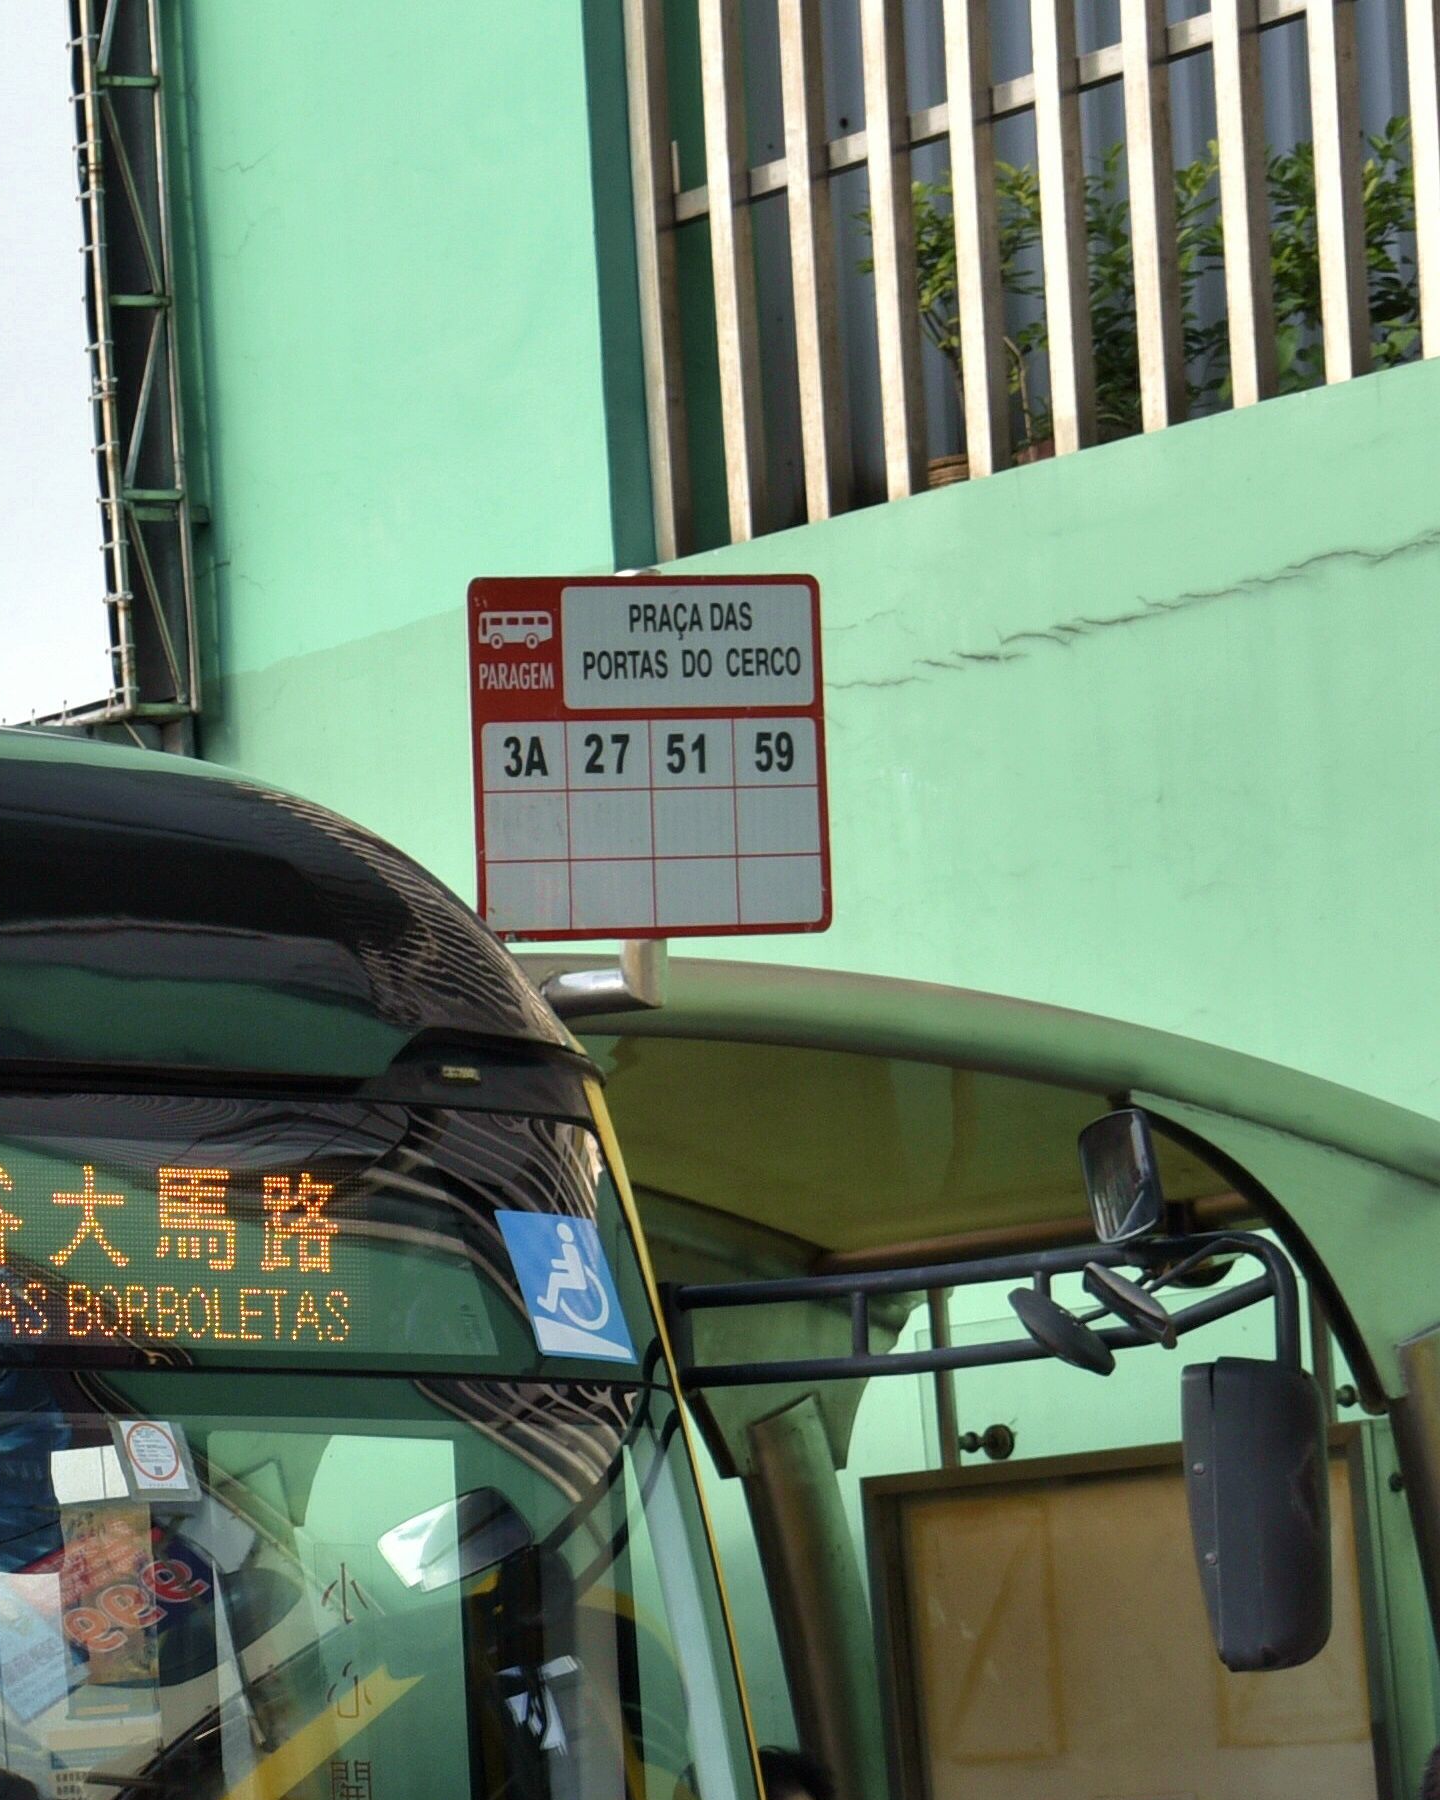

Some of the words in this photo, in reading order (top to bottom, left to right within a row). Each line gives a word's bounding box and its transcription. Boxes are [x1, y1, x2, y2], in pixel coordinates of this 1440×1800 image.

[628, 602, 704, 640] PRAÇA
[710, 602, 753, 632] DAS
[477, 661, 555, 691] PARAGEM
[582, 649, 668, 680] PORTAS
[681, 648, 713, 678] DO
[726, 646, 802, 678] CERCO
[503, 735, 549, 779] 3A
[584, 733, 631, 775] 27
[666, 732, 708, 775] 51
[754, 731, 795, 773] 59
[66, 1283, 351, 1342] BORBOLETAS
